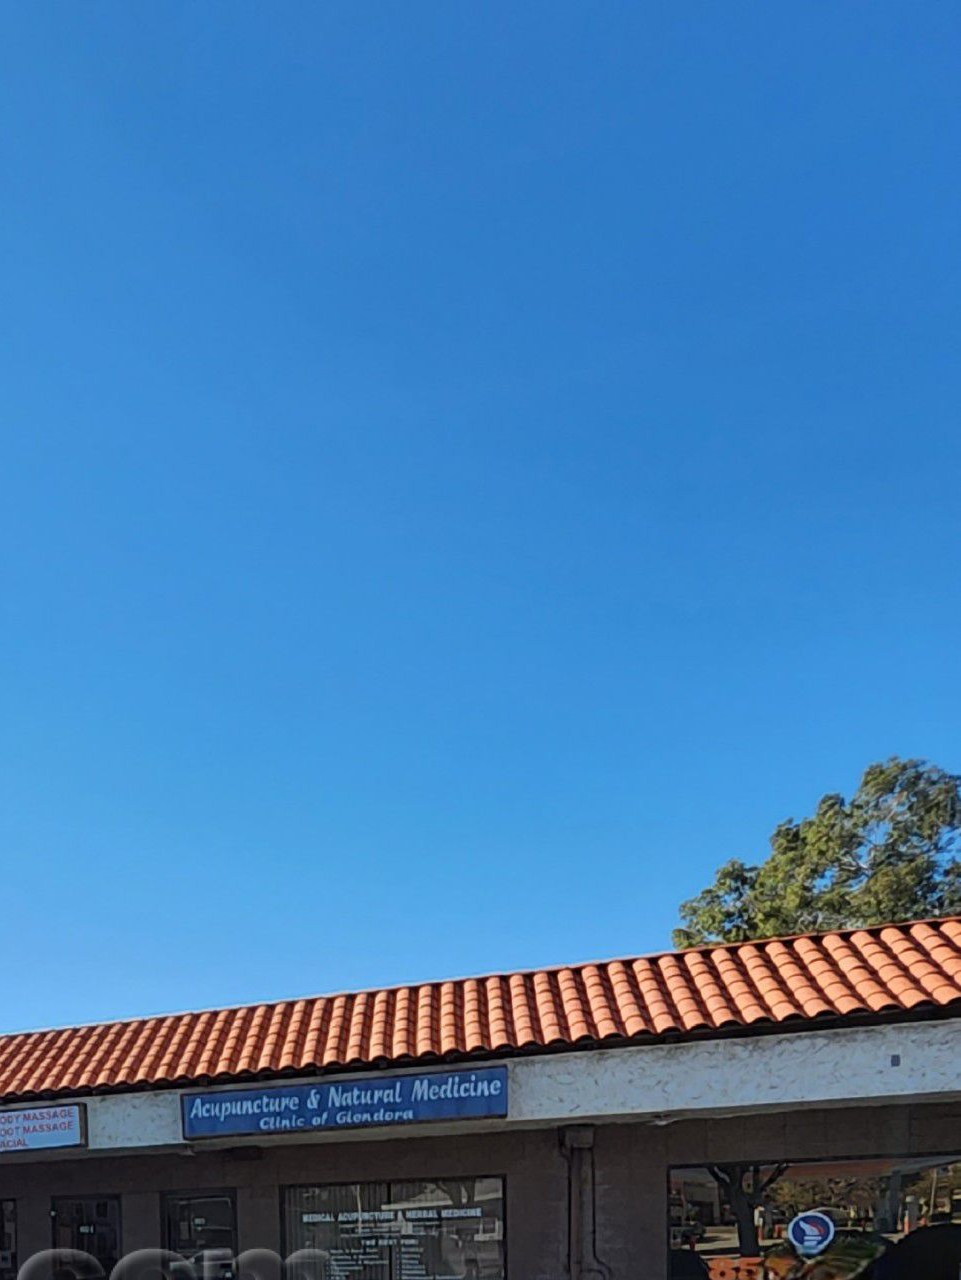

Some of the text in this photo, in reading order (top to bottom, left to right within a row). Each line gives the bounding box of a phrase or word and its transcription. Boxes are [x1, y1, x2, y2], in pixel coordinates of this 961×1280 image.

[190, 1075, 502, 1122] Acupuncture & Natural Medicine
[23, 1109, 75, 1123] MASSAGE
[260, 1114, 305, 1130] Clinic
[312, 1112, 331, 1126] of
[23, 1121, 74, 1134] MASSAGE
